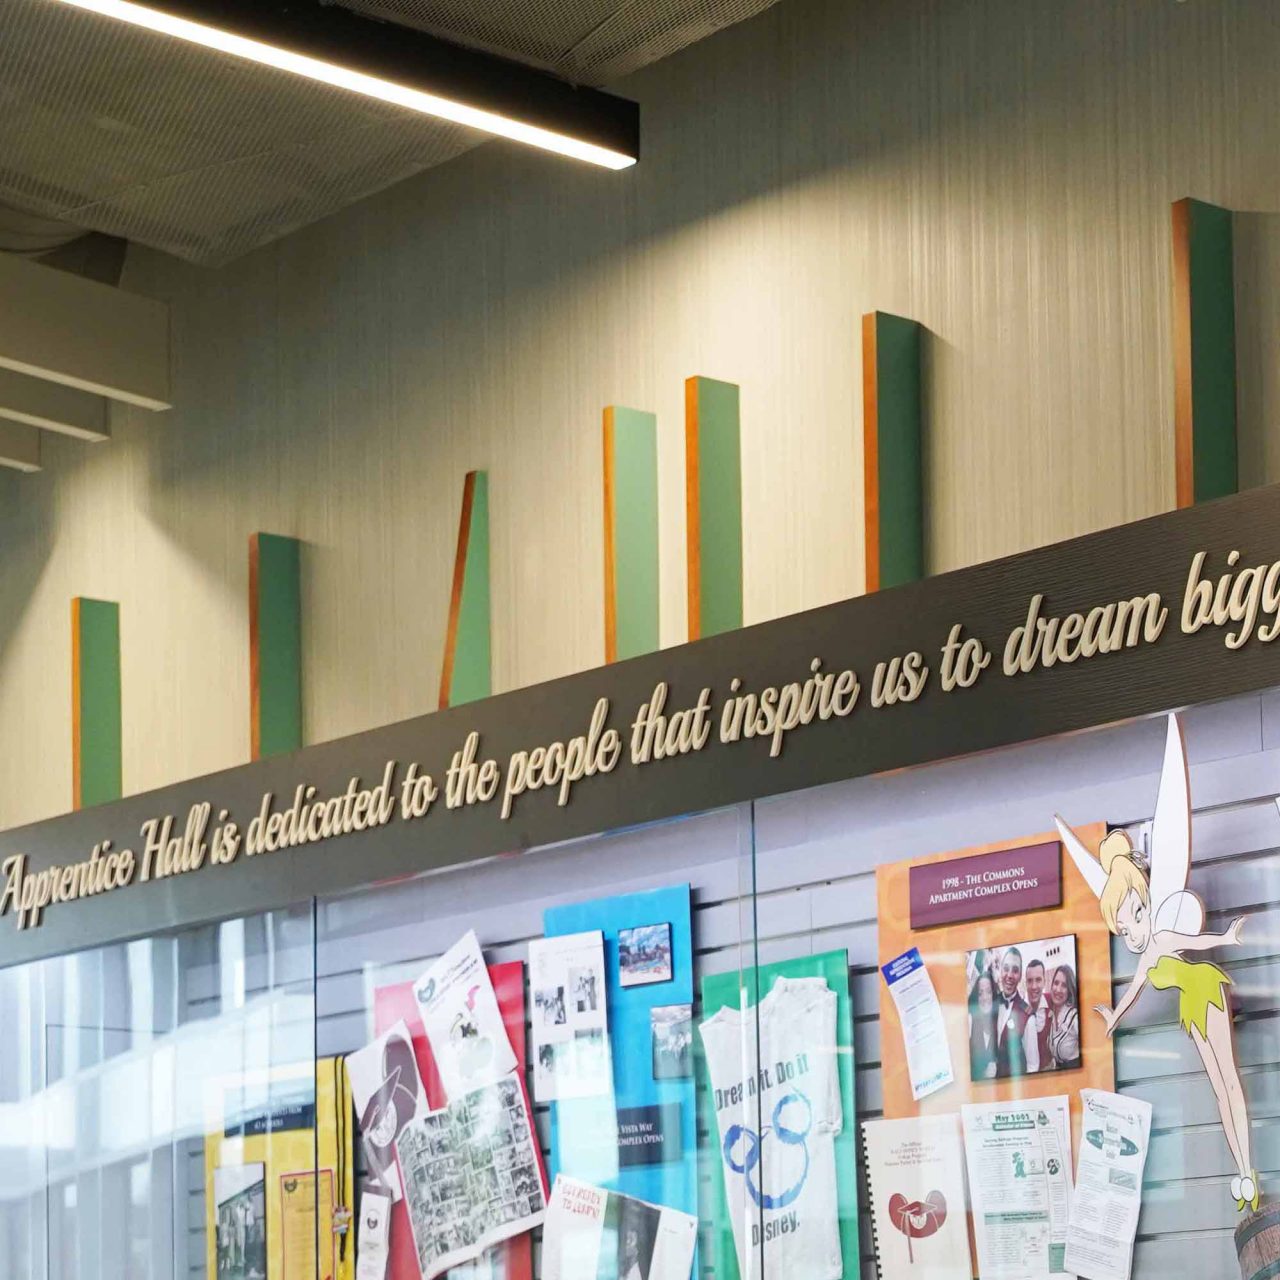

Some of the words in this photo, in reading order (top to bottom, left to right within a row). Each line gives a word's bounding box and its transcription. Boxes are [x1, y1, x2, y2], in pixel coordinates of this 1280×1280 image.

[0, 850, 135, 930] Apprentice
[140, 803, 210, 882] Hall
[211, 808, 241, 866] is
[246, 761, 394, 851] dedicated
[401, 763, 438, 819] to
[445, 732, 499, 809] the
[501, 698, 620, 819] people
[631, 682, 709, 764] that
[720, 671, 860, 757] inspire
[871, 652, 928, 707] us
[940, 624, 990, 690] to
[1004, 594, 1168, 676] dream
[942, 875, 960, 888] 1998
[965, 873, 982, 884] THE
[983, 867, 1025, 882] COMMONS
[929, 888, 973, 905] APARTMENT
[974, 883, 1011, 898] COMPLEX
[1012, 878, 1038, 891] OPENS
[776, 1061, 795, 1084] Do
[796, 1053, 809, 1074] it
[617, 1136, 643, 1146] OMPLEX
[643, 1133, 664, 1144] OPENS
[621, 1124, 638, 1134] VISTA
[639, 1122, 654, 1133] WAY
